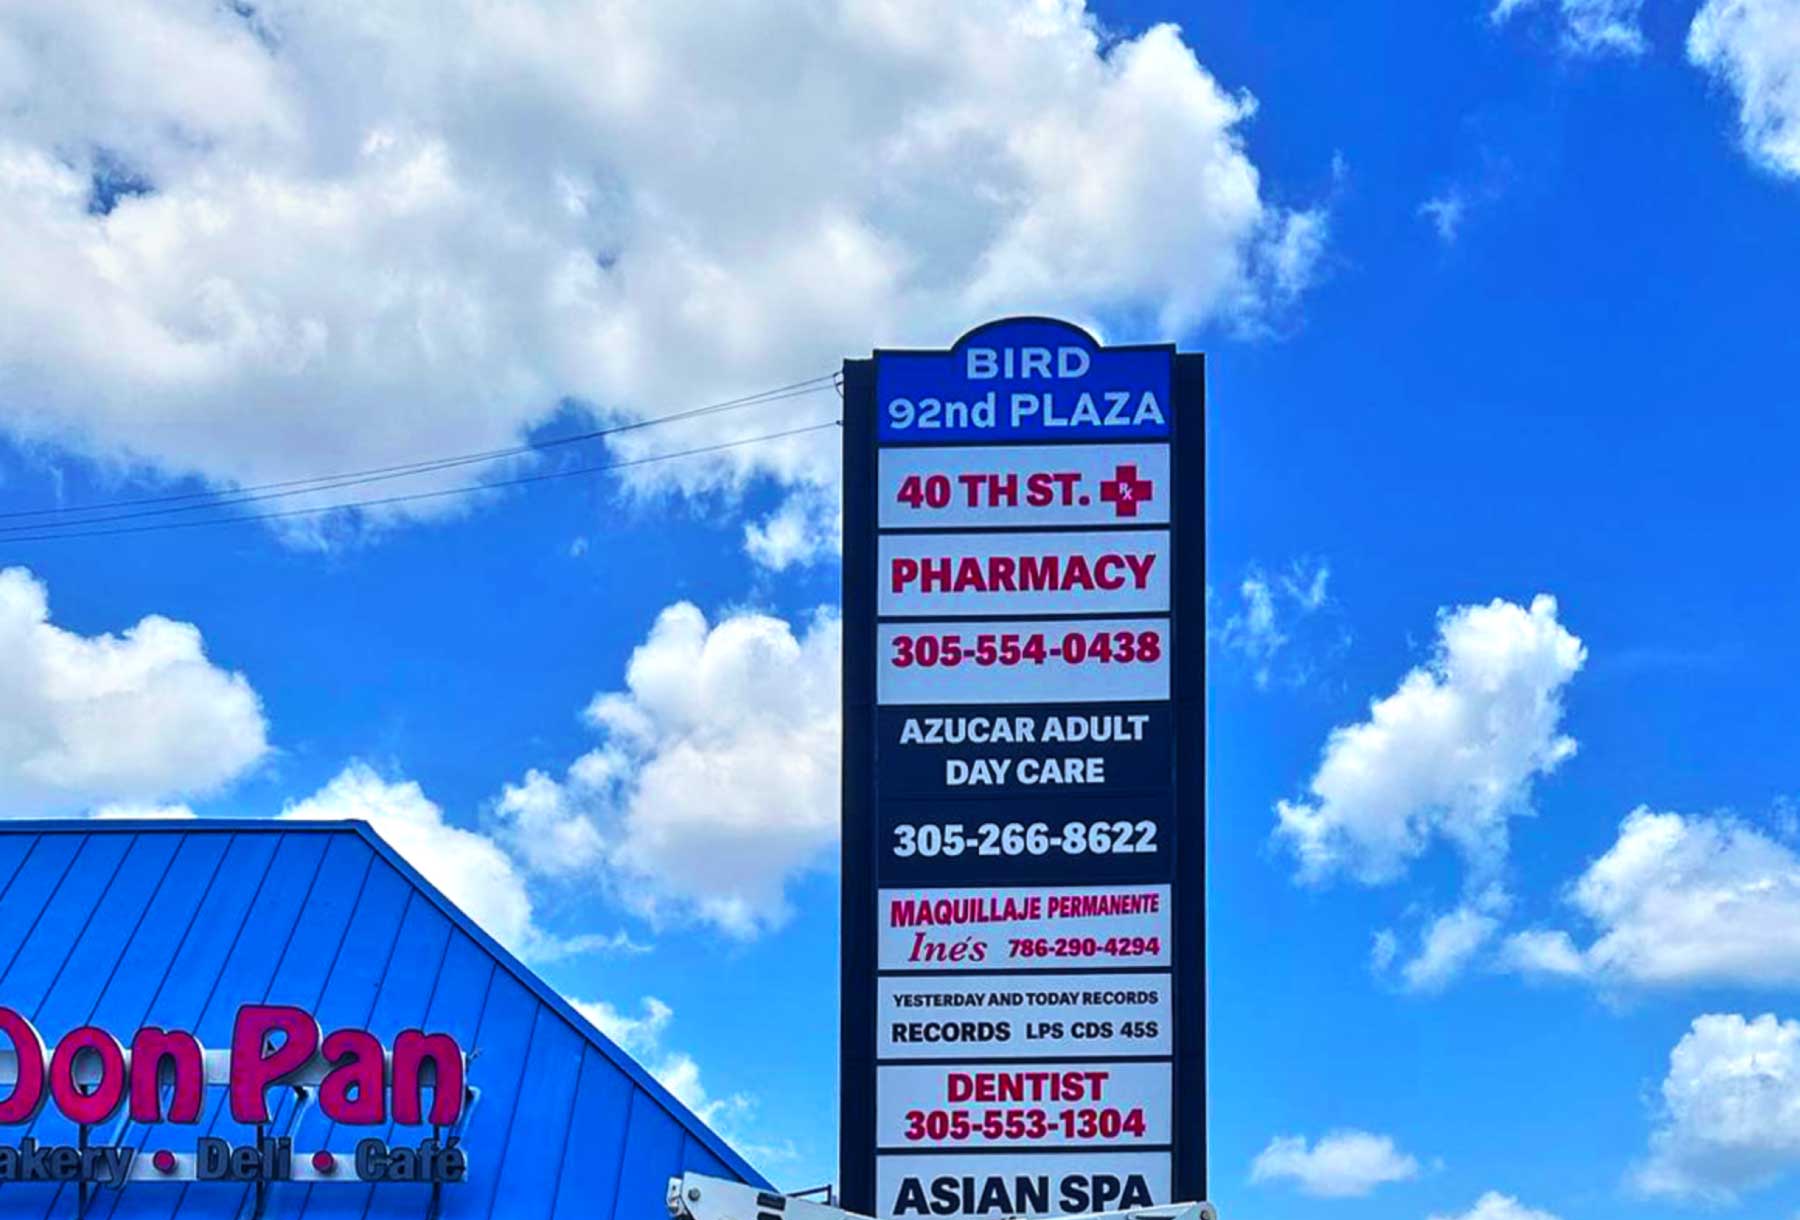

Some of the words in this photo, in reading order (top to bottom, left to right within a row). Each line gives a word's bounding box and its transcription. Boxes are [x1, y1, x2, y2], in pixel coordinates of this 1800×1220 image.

[966, 346, 1091, 380] BIRD
[888, 391, 996, 429] 92nd
[1010, 390, 1165, 427] PLAZA
[897, 475, 951, 509] 40
[958, 473, 1018, 507] TH
[1026, 472, 1091, 507] ST.
[891, 553, 1156, 593] PHARMACY
[891, 631, 1160, 667] 305-554-0438
[900, 716, 1035, 744] AZUCAR
[1042, 715, 1149, 742] ADULT
[946, 759, 1010, 785] DAY
[1016, 757, 1105, 784] CARE
[893, 820, 1157, 857] 305-266-8622
[890, 897, 1041, 927] MAQUILLAJE
[1047, 893, 1159, 919] PERMANENTE
[1008, 936, 1160, 958] 786-290-4294
[893, 992, 986, 1007] YESTERDAY
[987, 992, 1024, 1006] AND
[1025, 991, 1080, 1006] TODAY
[1082, 990, 1159, 1005] RECORDS
[892, 1022, 1011, 1043] RECORDS
[1026, 1022, 1064, 1040] LPS
[1070, 1021, 1114, 1039] CDS
[1119, 1021, 1159, 1038] 45S
[230, 1002, 466, 1127] Pan
[947, 1072, 1109, 1102] DENTIST
[904, 1108, 1146, 1140] 305-553-1304
[196, 1136, 292, 1183] Deli
[355, 1135, 467, 1183] Café
[893, 1175, 1049, 1216] ASIAN
[1058, 1174, 1154, 1215] SPA
